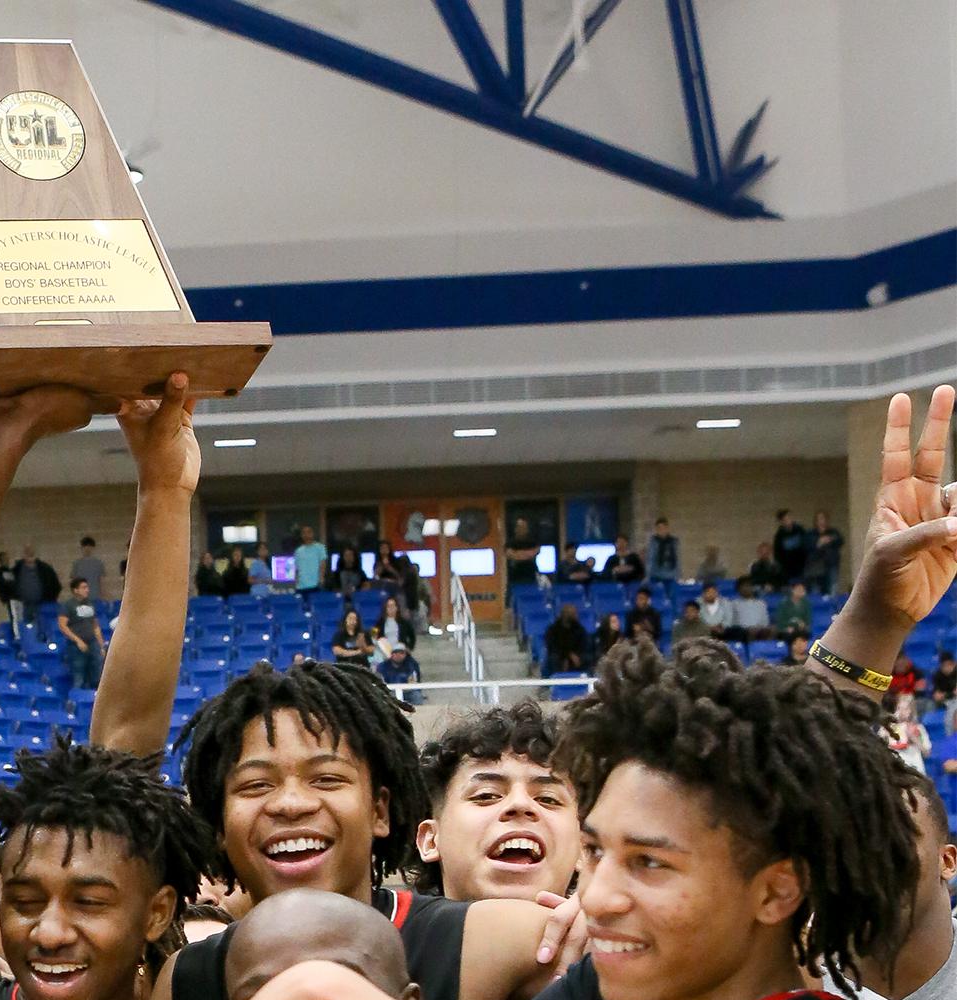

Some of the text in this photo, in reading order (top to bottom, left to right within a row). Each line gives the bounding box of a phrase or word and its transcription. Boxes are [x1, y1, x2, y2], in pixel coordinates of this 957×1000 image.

[16, 149, 62, 161] REGIONAL
[9, 231, 115, 252] INTERSCHOLASTIC
[115, 245, 157, 276] LEAGUE
[53, 260, 111, 271] CHAMPION
[4, 278, 108, 289] BOYS' BASKETBALL
[1, 294, 116, 306] CONFERENCE AAAAA
[823, 654, 852, 674] Alpha
